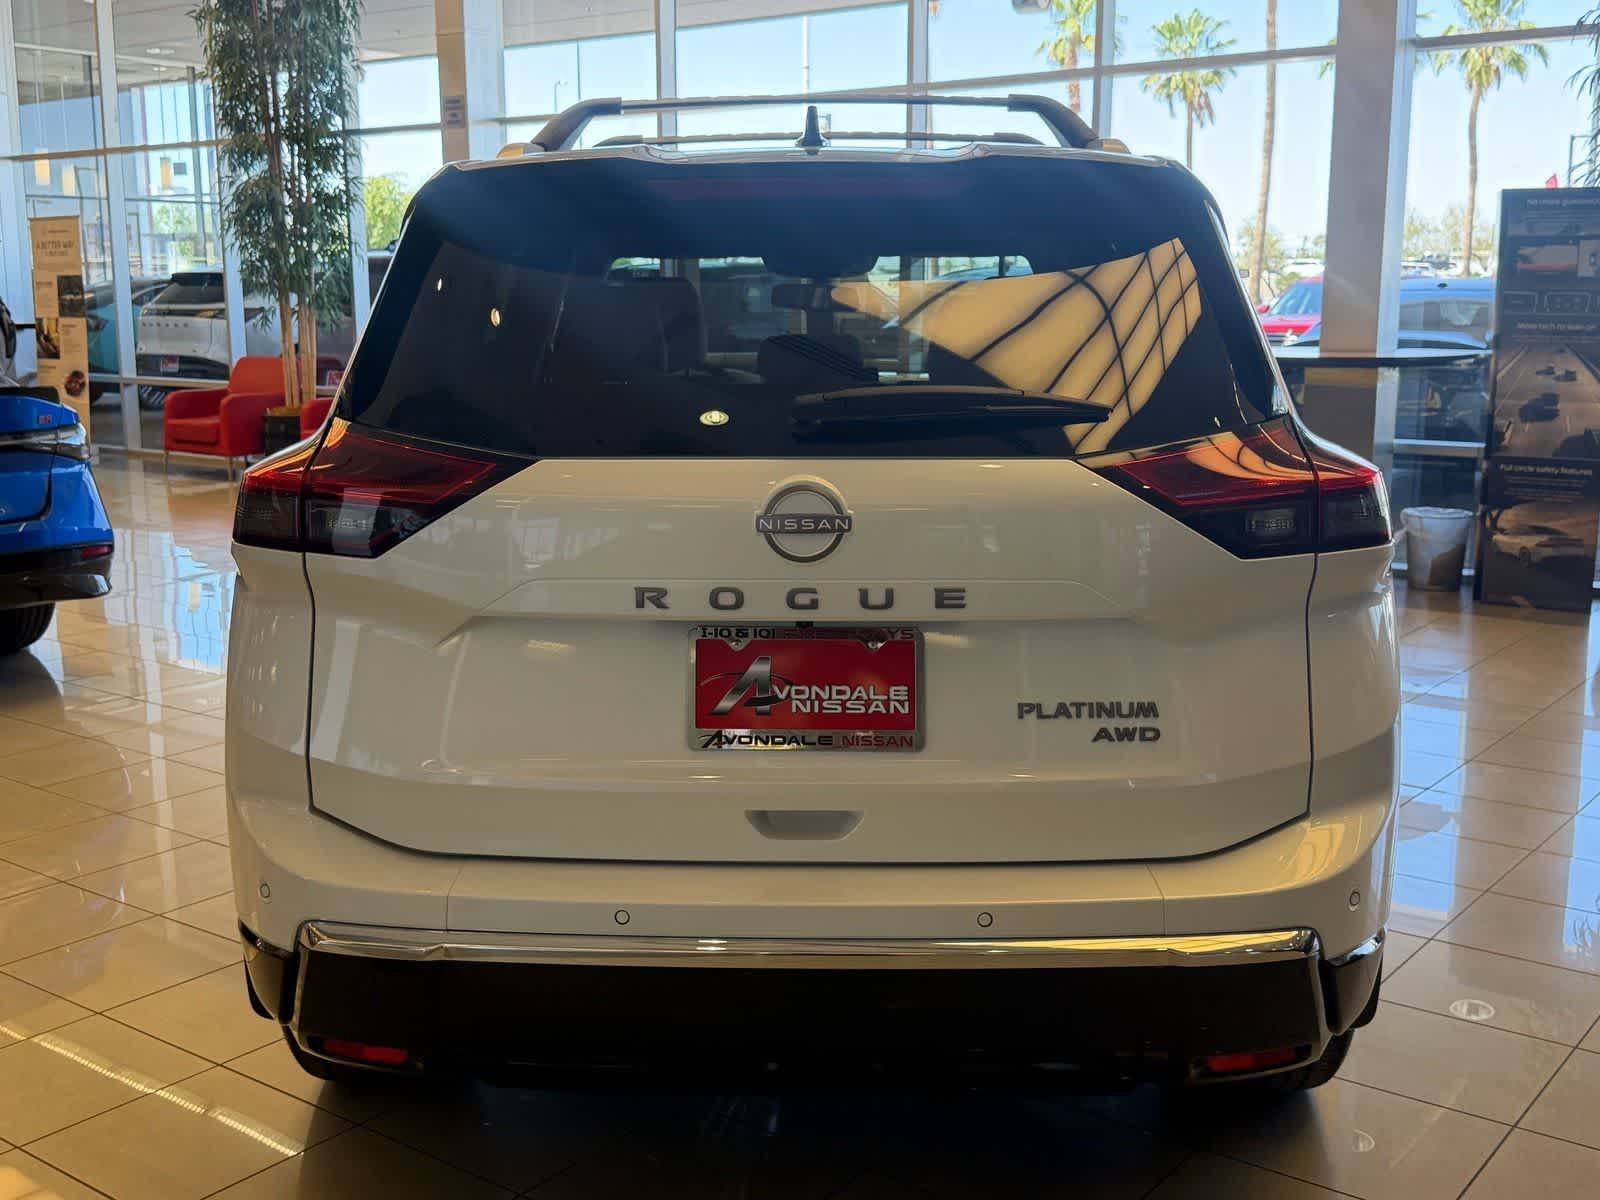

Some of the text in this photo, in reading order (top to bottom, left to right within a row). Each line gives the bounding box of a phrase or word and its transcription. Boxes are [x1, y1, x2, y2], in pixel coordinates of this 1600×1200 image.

[759, 519, 849, 530] NISSAN
[633, 586, 967, 610] ROGUE
[701, 627, 731, 639] I-10
[709, 655, 909, 715] AVONDALE
[791, 700, 910, 714] NISSAN
[1017, 701, 1160, 720] PLATINUM
[700, 730, 914, 749] AVONDALE NISSAN
[1091, 726, 1161, 743] AWD
